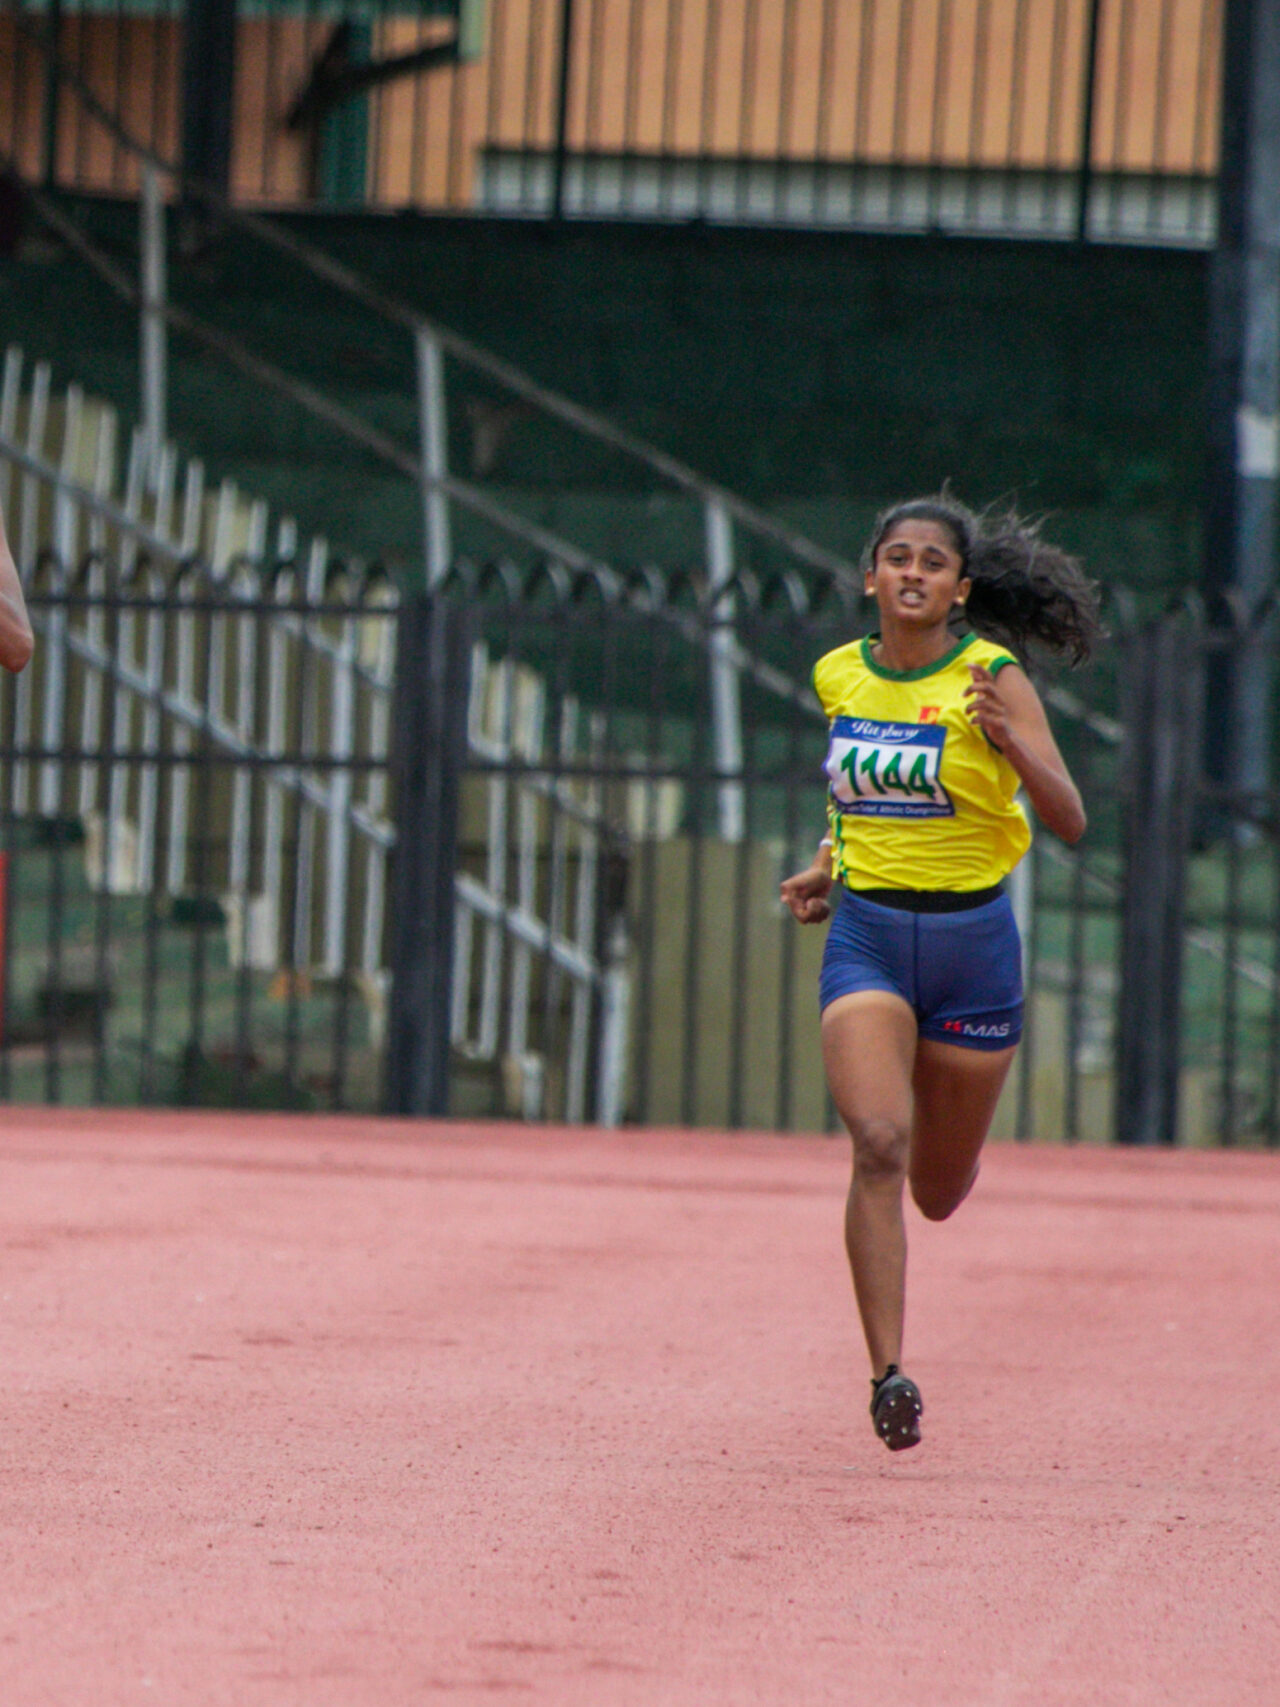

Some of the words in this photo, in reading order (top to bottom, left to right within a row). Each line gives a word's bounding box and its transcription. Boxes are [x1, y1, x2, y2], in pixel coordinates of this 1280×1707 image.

[851, 720, 919, 740] Ritzbury
[841, 746, 936, 800] 1144
[963, 1023, 1011, 1037] MAS
